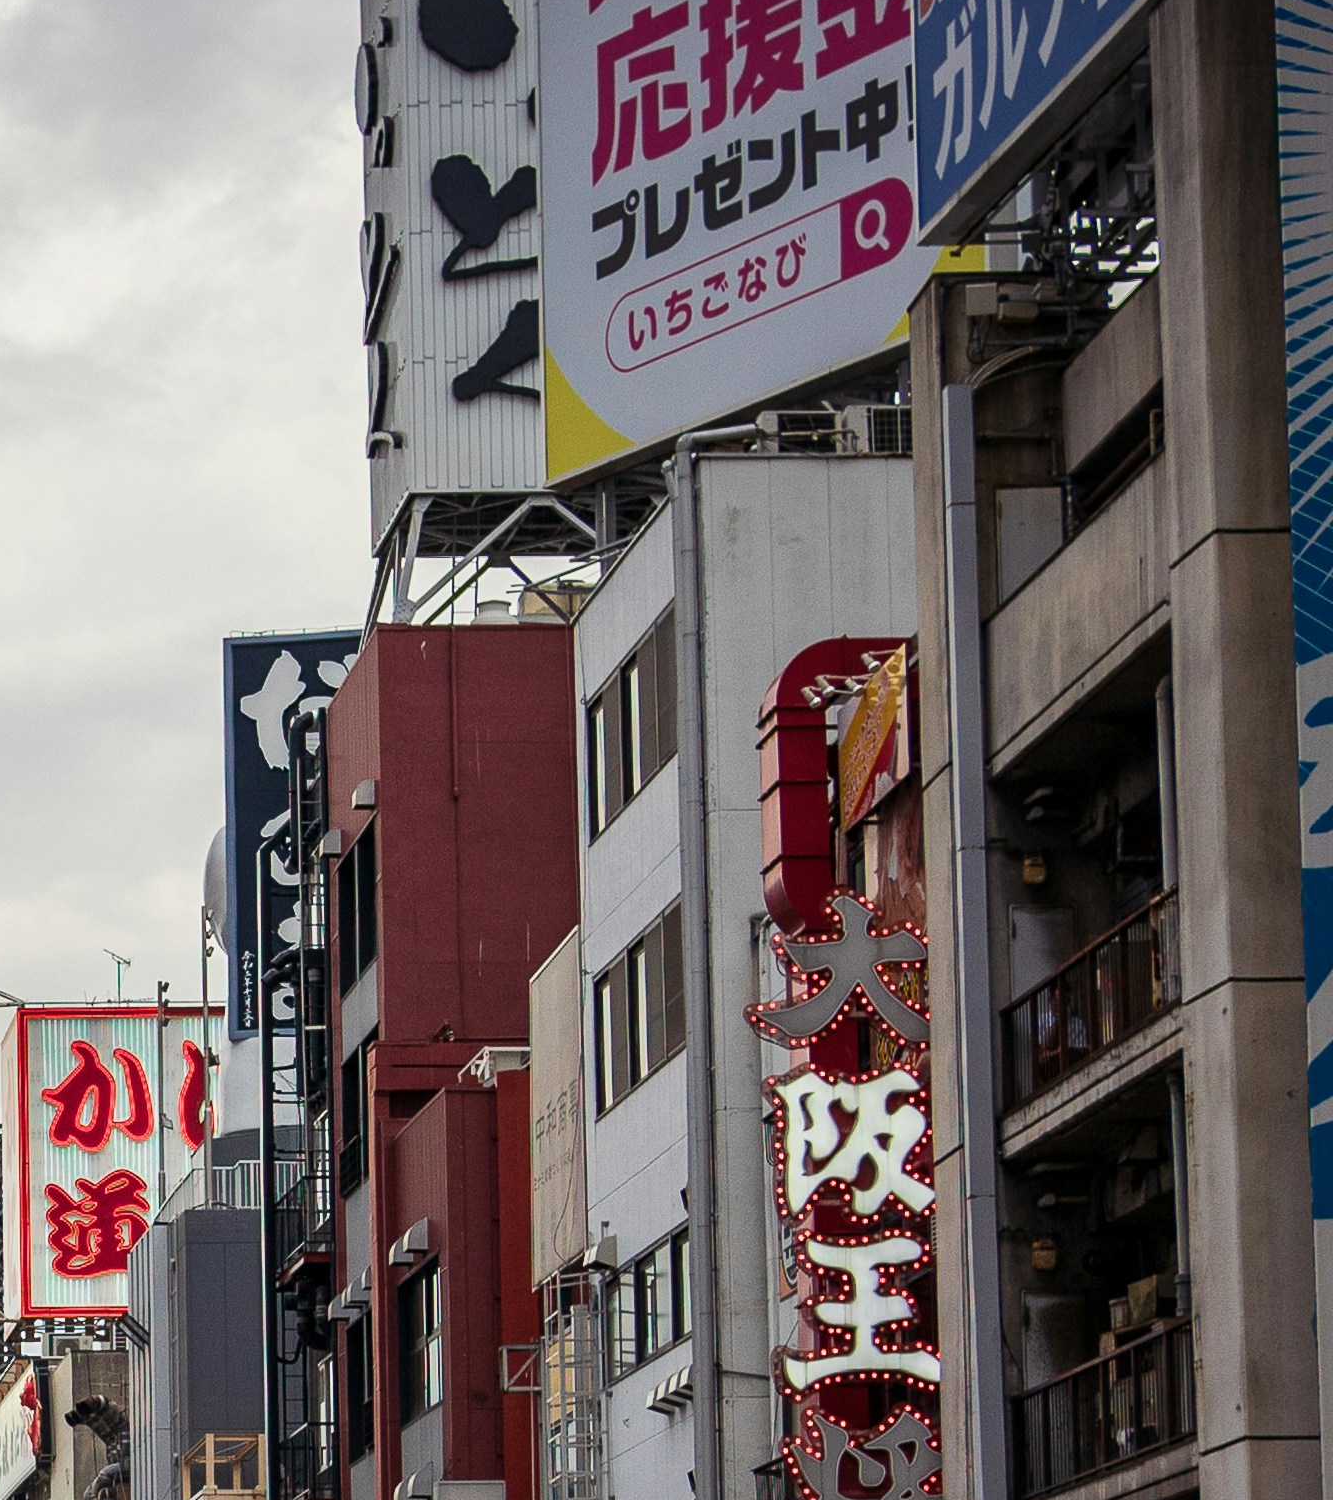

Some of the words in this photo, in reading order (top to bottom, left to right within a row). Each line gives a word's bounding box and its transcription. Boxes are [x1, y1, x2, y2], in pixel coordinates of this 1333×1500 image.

[625, 234, 808, 353] いちごなび
